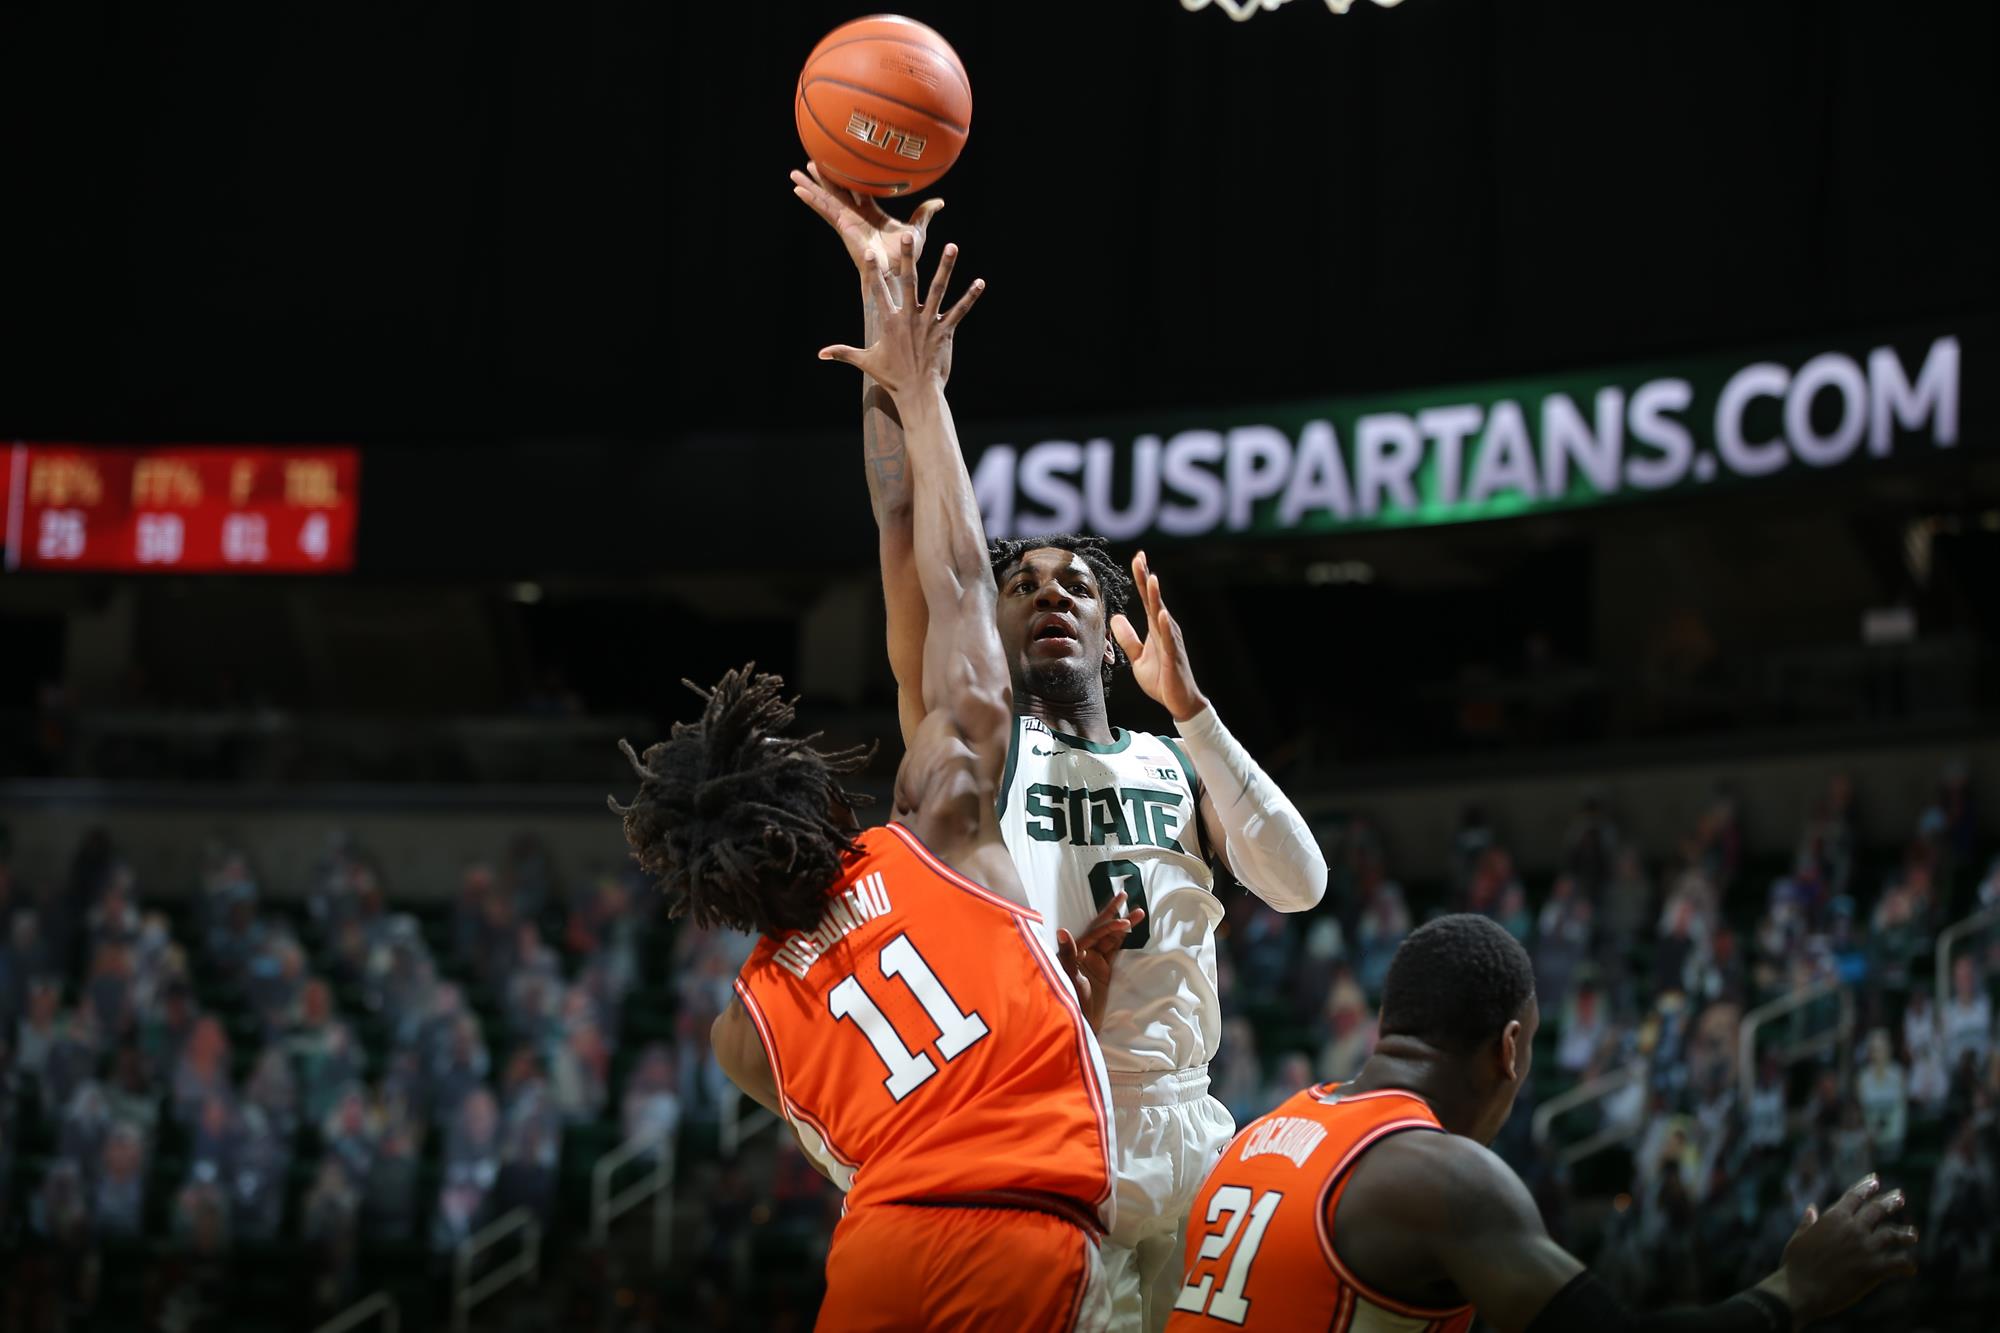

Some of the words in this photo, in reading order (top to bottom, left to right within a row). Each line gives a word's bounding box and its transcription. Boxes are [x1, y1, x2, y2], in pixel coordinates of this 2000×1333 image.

[846, 111, 927, 160] ELITE
[1026, 782, 1185, 854] STATE
[772, 871, 892, 981] DOSUNMU
[1088, 859, 1151, 949] 0
[828, 932, 992, 1104] 11
[1173, 1184, 1285, 1327] 21
